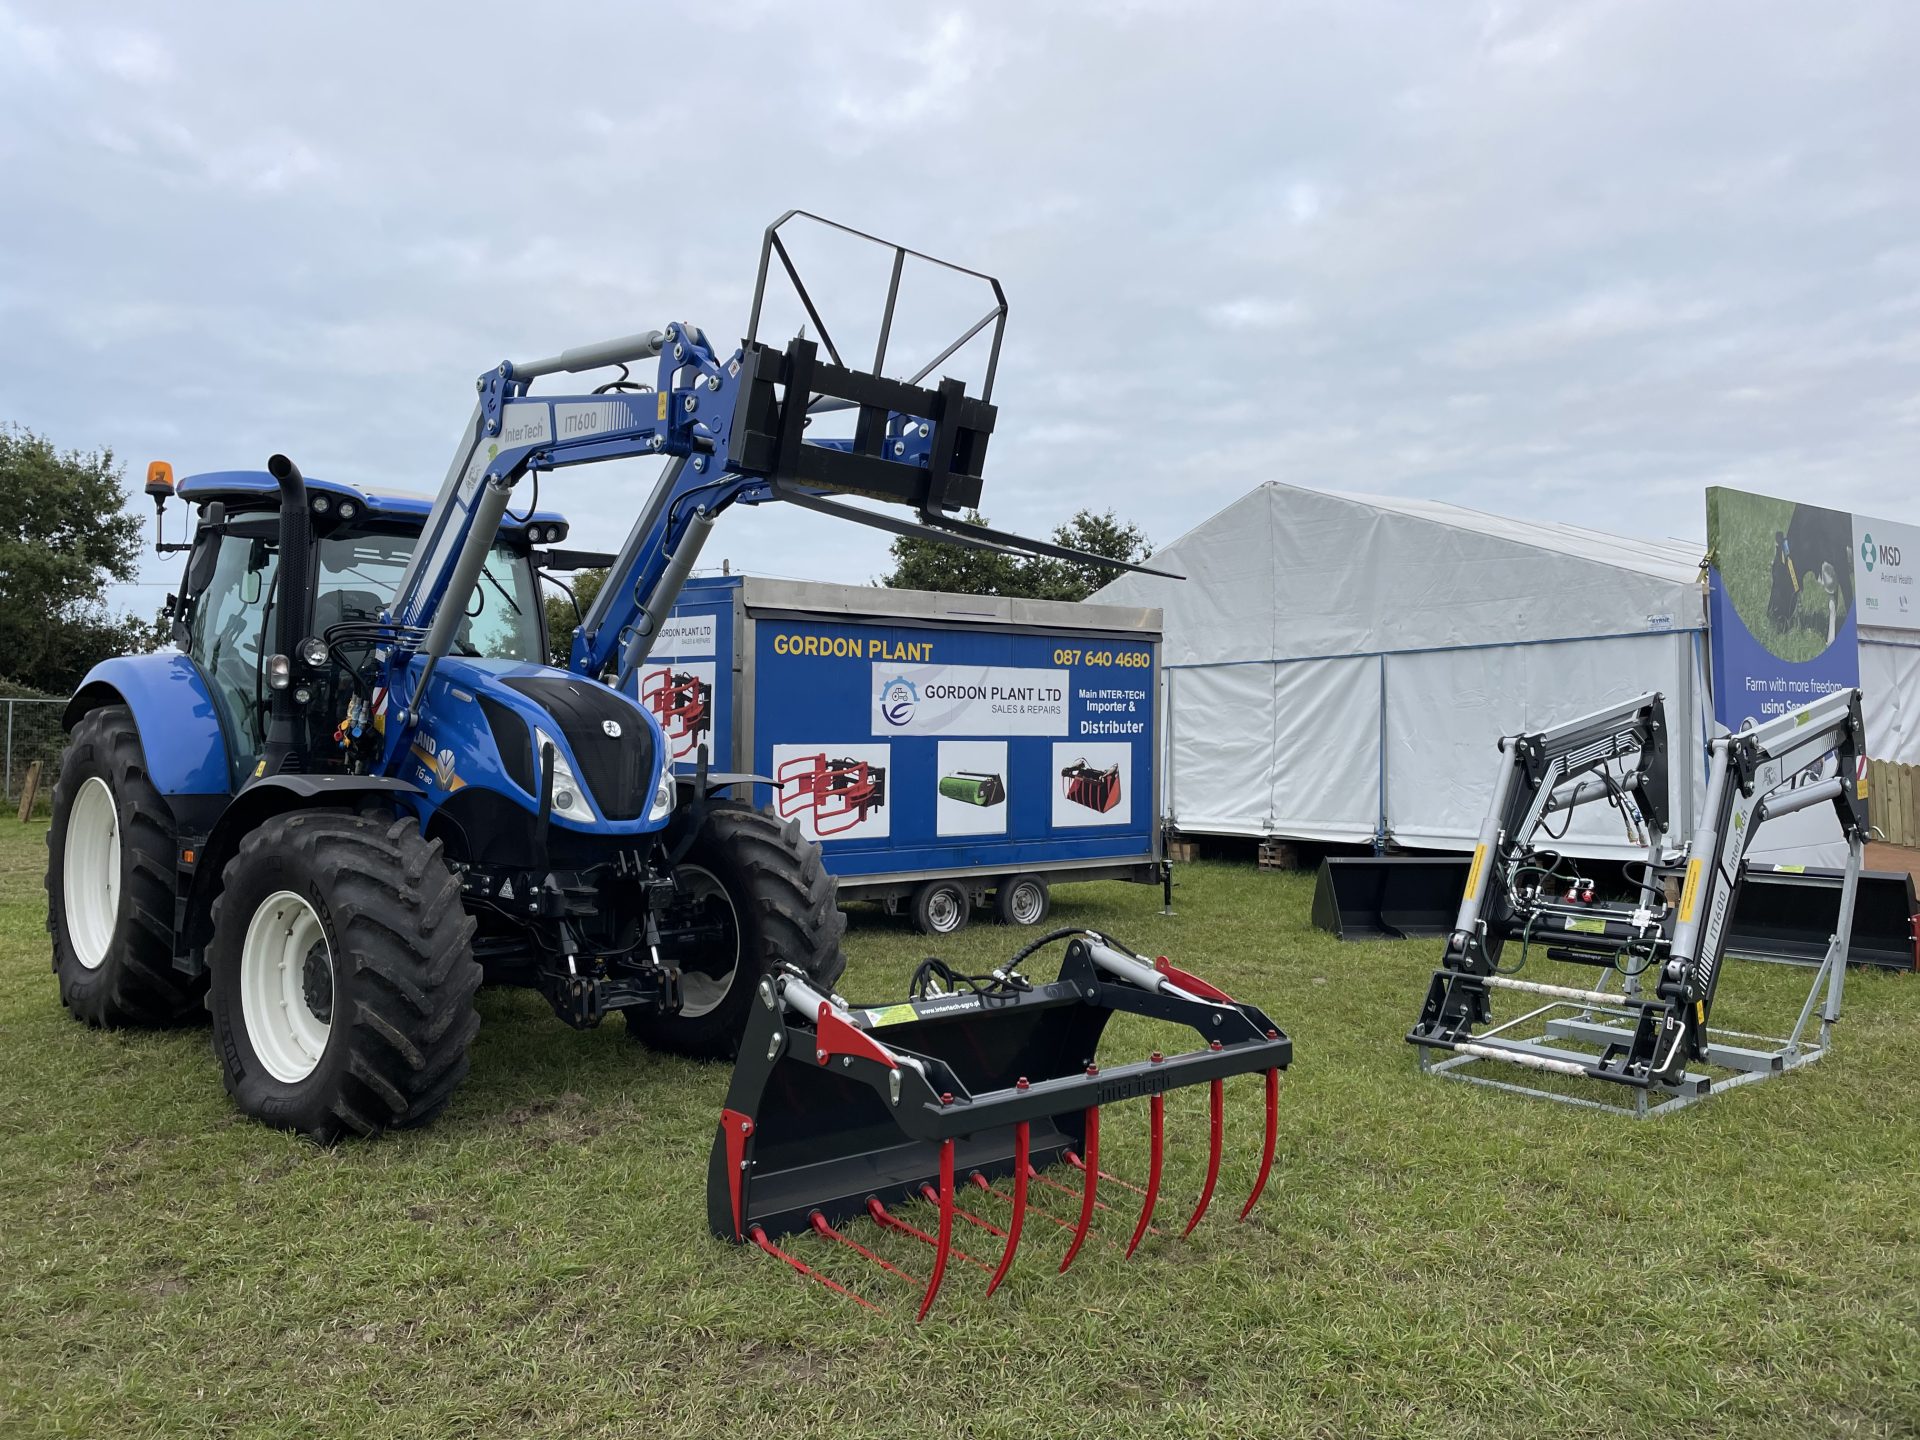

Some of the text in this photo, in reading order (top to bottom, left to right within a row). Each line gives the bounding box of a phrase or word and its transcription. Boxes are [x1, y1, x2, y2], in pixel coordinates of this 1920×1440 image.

[564, 411, 598, 433] IT1600
[504, 422, 544, 443] InterTech
[1879, 545, 1901, 567] MSD
[1880, 572, 1914, 585] Animal Health
[681, 626, 700, 637] PLANT
[700, 626, 711, 636] LTD
[774, 634, 933, 662] GORDON PLANT
[1053, 649, 1150, 668] 087 640 4680
[925, 684, 1062, 702] GORDON PLANT LTD
[1745, 676, 1842, 693] Farm with more freedom
[1078, 688, 1145, 700] Main INTER-TECH
[991, 704, 1061, 715] SALES & REPAIRS
[1086, 700, 1136, 714] Importer &
[1761, 698, 1785, 715] using
[1080, 720, 1144, 735] Distributer
[1709, 891, 1727, 940] IT1600
